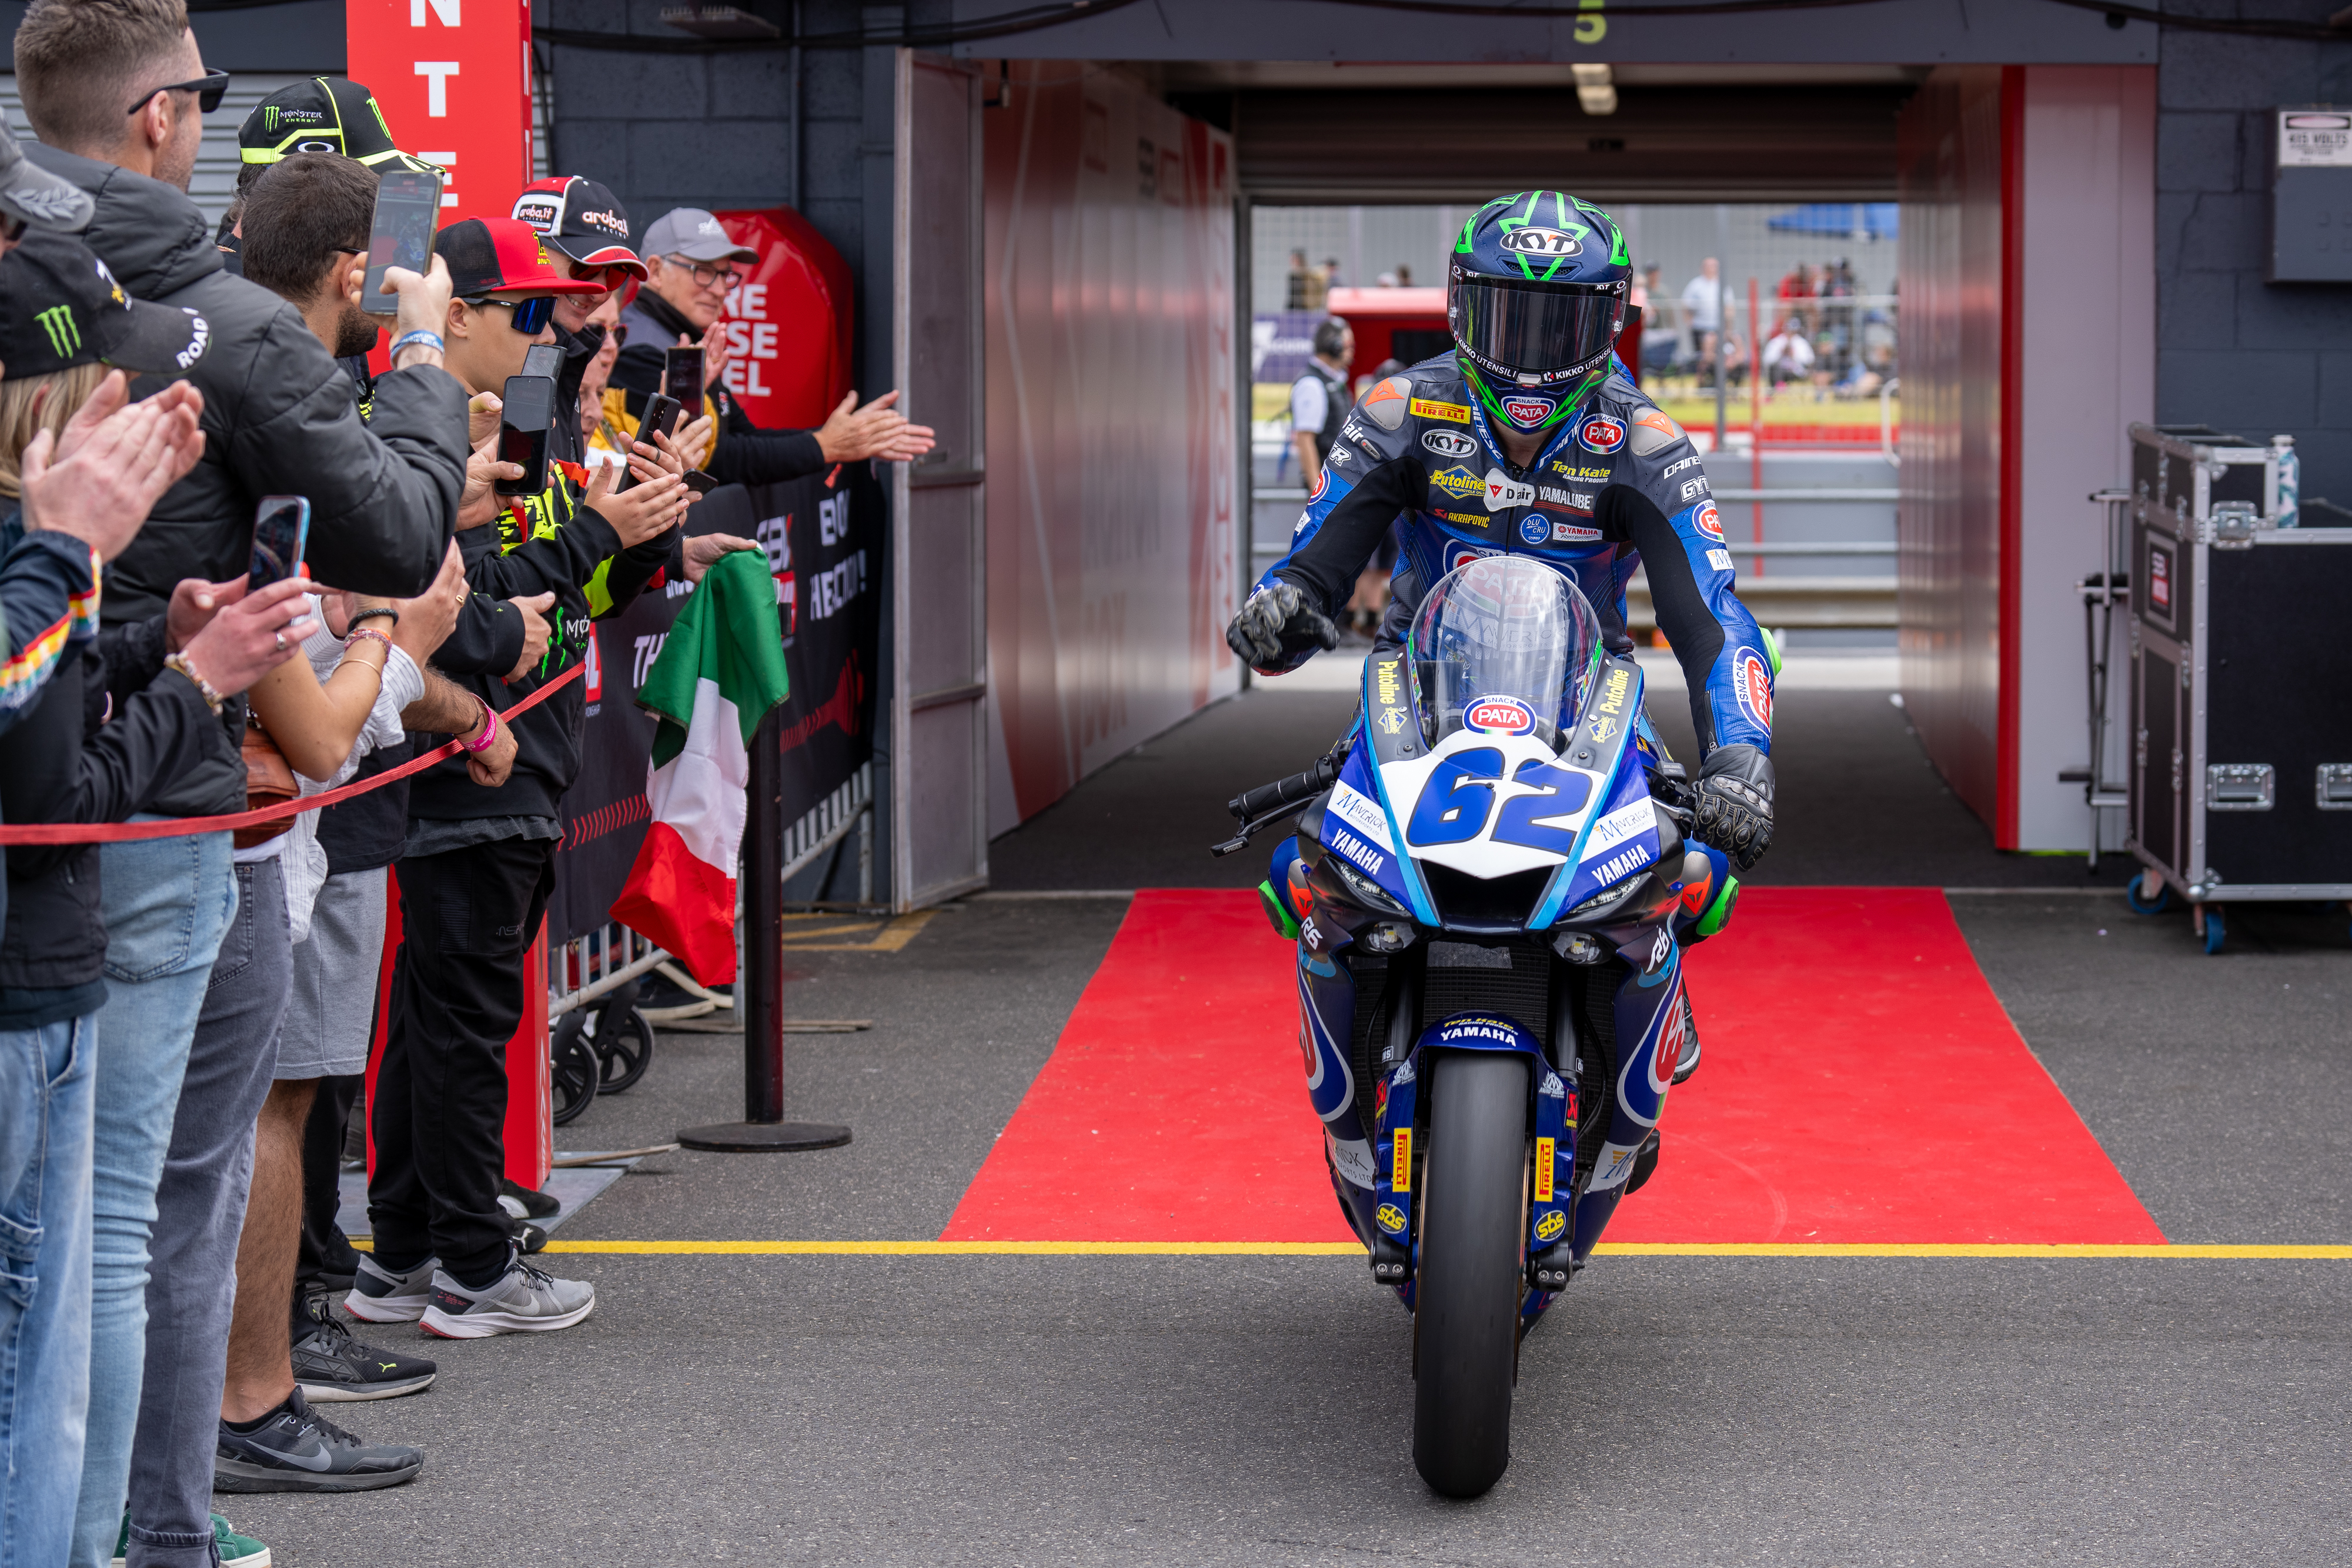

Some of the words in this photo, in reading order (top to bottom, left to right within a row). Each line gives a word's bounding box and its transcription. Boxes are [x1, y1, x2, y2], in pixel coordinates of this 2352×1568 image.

[1573, 0, 1607, 45] 5
[280, 109, 322, 119] MONSTER
[519, 205, 553, 219] aruba.it
[1509, 232, 1575, 252] KYT
[720, 283, 768, 320] RE
[176, 317, 209, 369] ROAD
[726, 320, 779, 359] SE
[1458, 337, 1476, 359] KIKKO
[722, 358, 772, 397] EL
[1555, 365, 1584, 380] KIKKO
[1415, 402, 1466, 420] PIRELLI
[1511, 404, 1545, 418] PATA
[1596, 414, 1618, 424] SNACK
[1428, 433, 1473, 453] KYT
[1588, 426, 1615, 442] PATA
[1429, 470, 1486, 492] Putoline
[1552, 460, 1576, 476] Ten
[1578, 467, 1611, 477] Kate
[1562, 474, 1585, 482] RACING
[1539, 486, 1591, 510] YAMALUBE
[1567, 527, 1599, 536] YAMAHA
[1467, 560, 1544, 599] PATA
[1378, 660, 1401, 705] Putoline
[1599, 668, 1629, 715] Putoline
[1736, 664, 1749, 701] SNACK
[1486, 697, 1516, 706] SNACK
[1478, 708, 1522, 726] PATA
[1335, 793, 1387, 832] MAVERICK
[1405, 746, 1593, 857] 62
[1599, 807, 1652, 842] MAVERICK
[1223, 841, 1244, 854] SPIDER
[1331, 827, 1384, 875] YAMAHA
[1591, 844, 1651, 887] YAMAHA
[1301, 916, 1324, 950] R6
[1645, 927, 1669, 974] R6
[1441, 1027, 1516, 1047] YAMAHA
[1396, 1134, 1408, 1186] PIRELLI
[1539, 1144, 1551, 1196] PIRELLI
[1377, 1206, 1406, 1231] sbs
[1538, 1212, 1565, 1239] sbs
